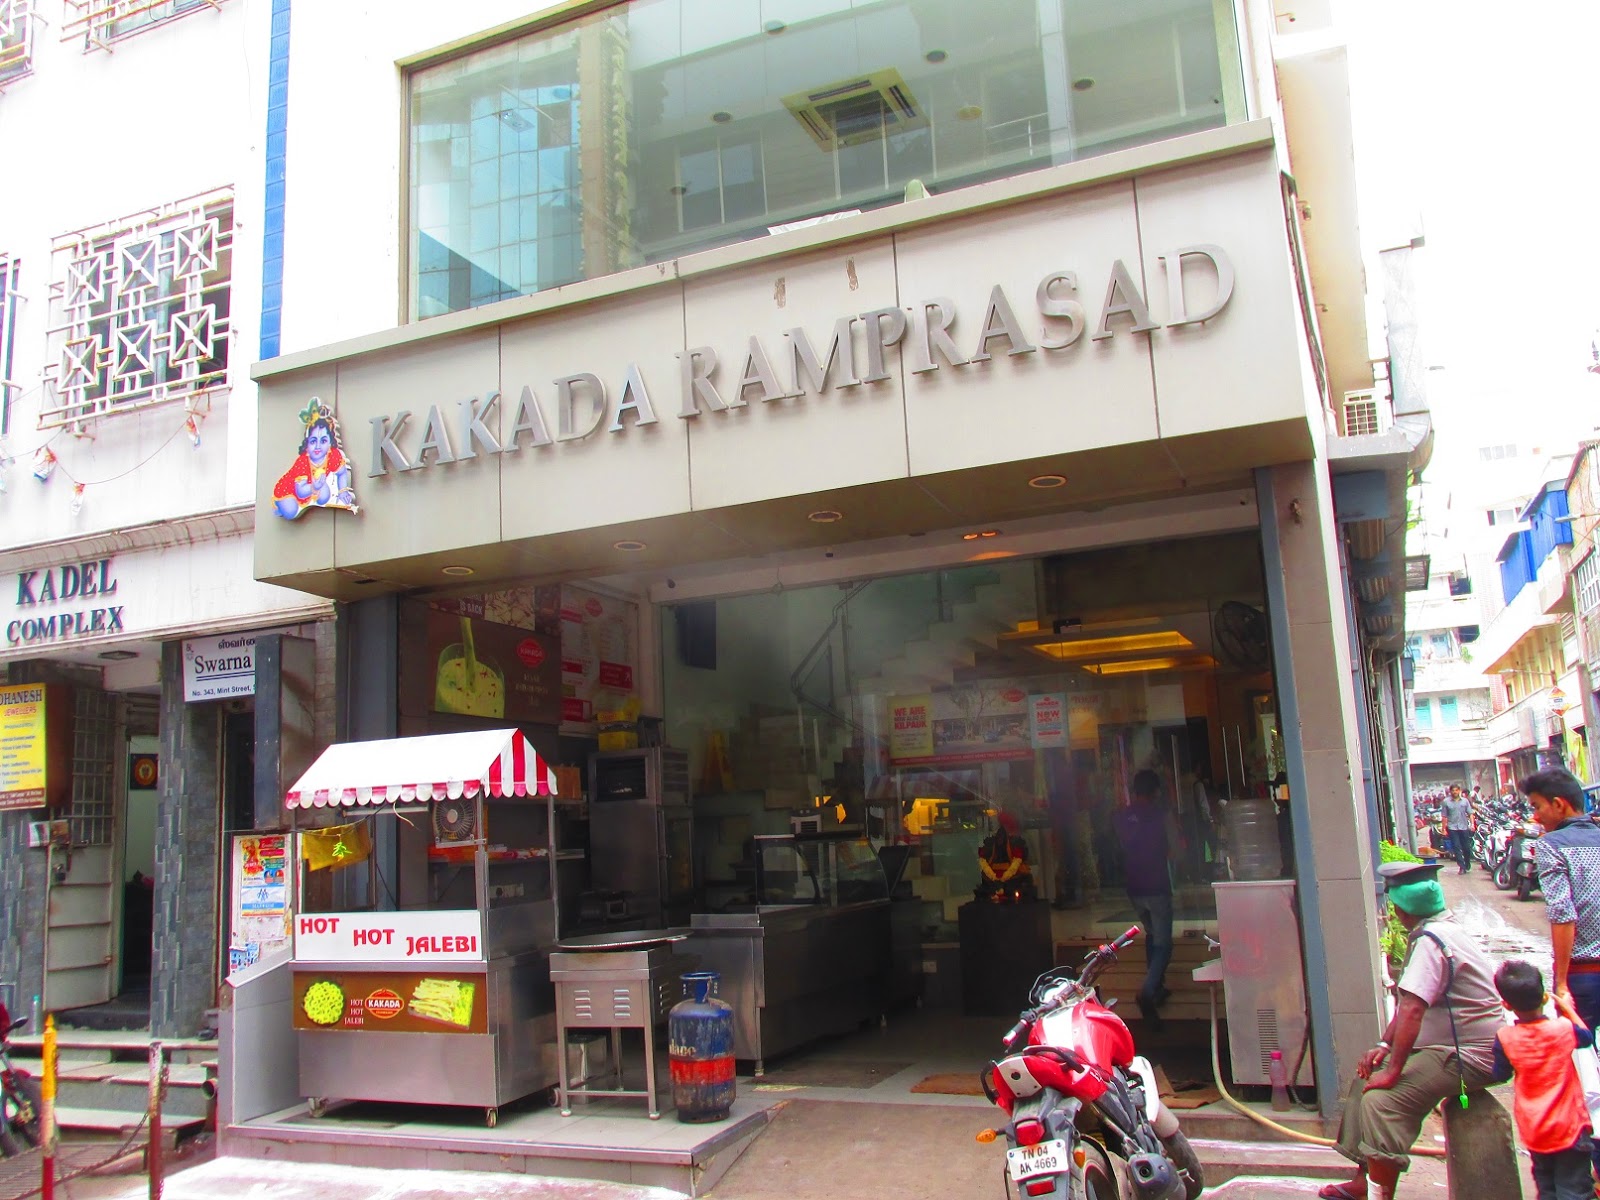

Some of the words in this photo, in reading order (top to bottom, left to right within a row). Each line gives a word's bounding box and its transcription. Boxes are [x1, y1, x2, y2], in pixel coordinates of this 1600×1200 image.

[367, 363, 659, 480] KAKADA
[675, 244, 1236, 419] RAMPRASAD
[16, 559, 117, 605] KADEL
[6, 606, 124, 643] COMPLEX
[194, 655, 252, 674] Swarna
[231, 685, 252, 693] Street,
[894, 707, 906, 716] WE
[300, 918, 339, 935] HOT
[353, 929, 395, 947] HOT
[406, 936, 477, 956] JALEBI
[368, 999, 400, 1008] KAKADA
[1022, 1149, 1034, 1160] TN
[1037, 1146, 1048, 1157] 04
[1020, 1162, 1032, 1175] AK
[1034, 1157, 1057, 1169] 4669
